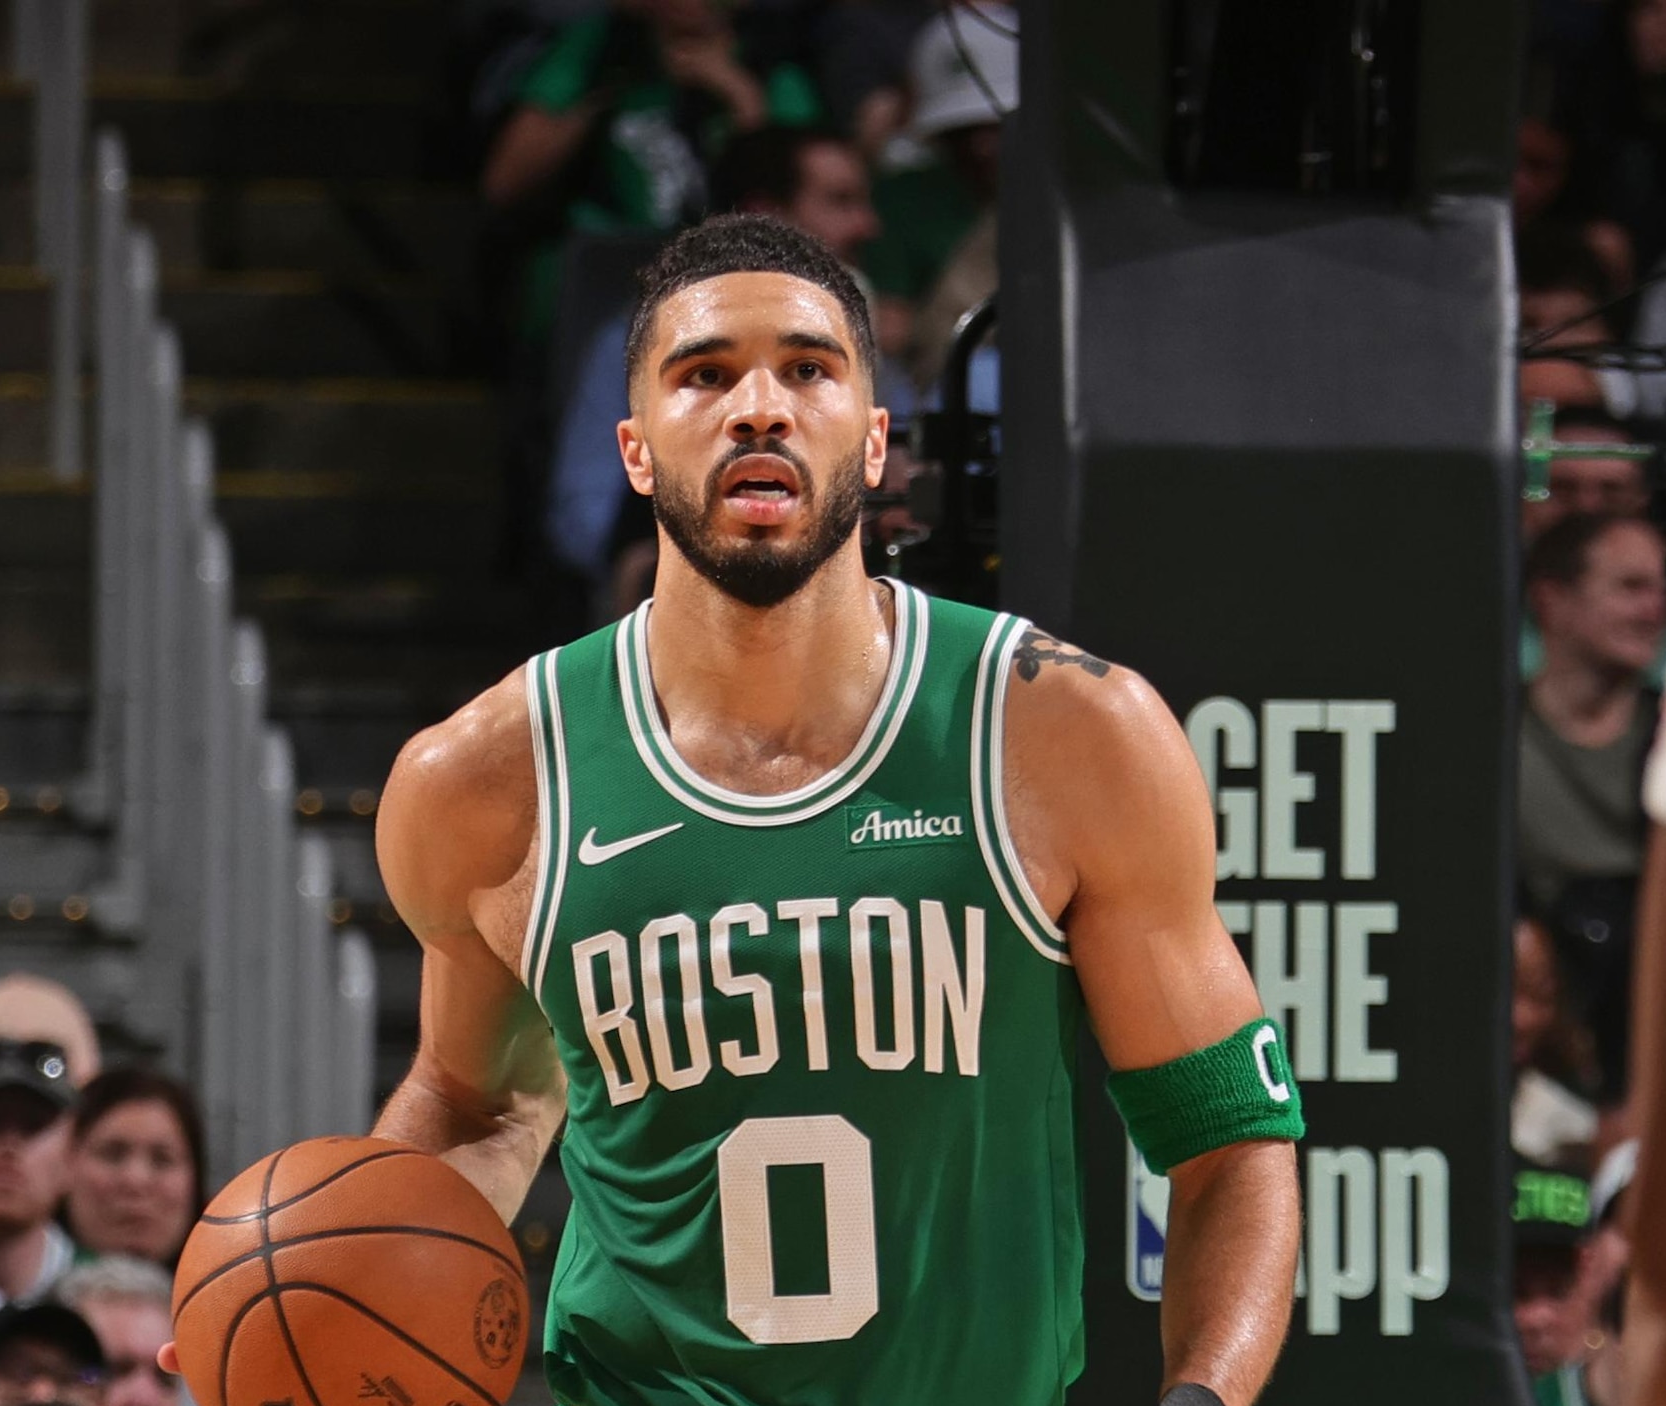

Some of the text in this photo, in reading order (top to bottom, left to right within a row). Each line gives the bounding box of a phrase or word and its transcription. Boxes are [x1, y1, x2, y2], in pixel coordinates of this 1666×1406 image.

[850, 809, 964, 844] Amica
[1184, 697, 1396, 881] GET
[571, 897, 986, 1107] BOSTON
[717, 1114, 880, 1345] 0
[1295, 1146, 1450, 1337] pp
